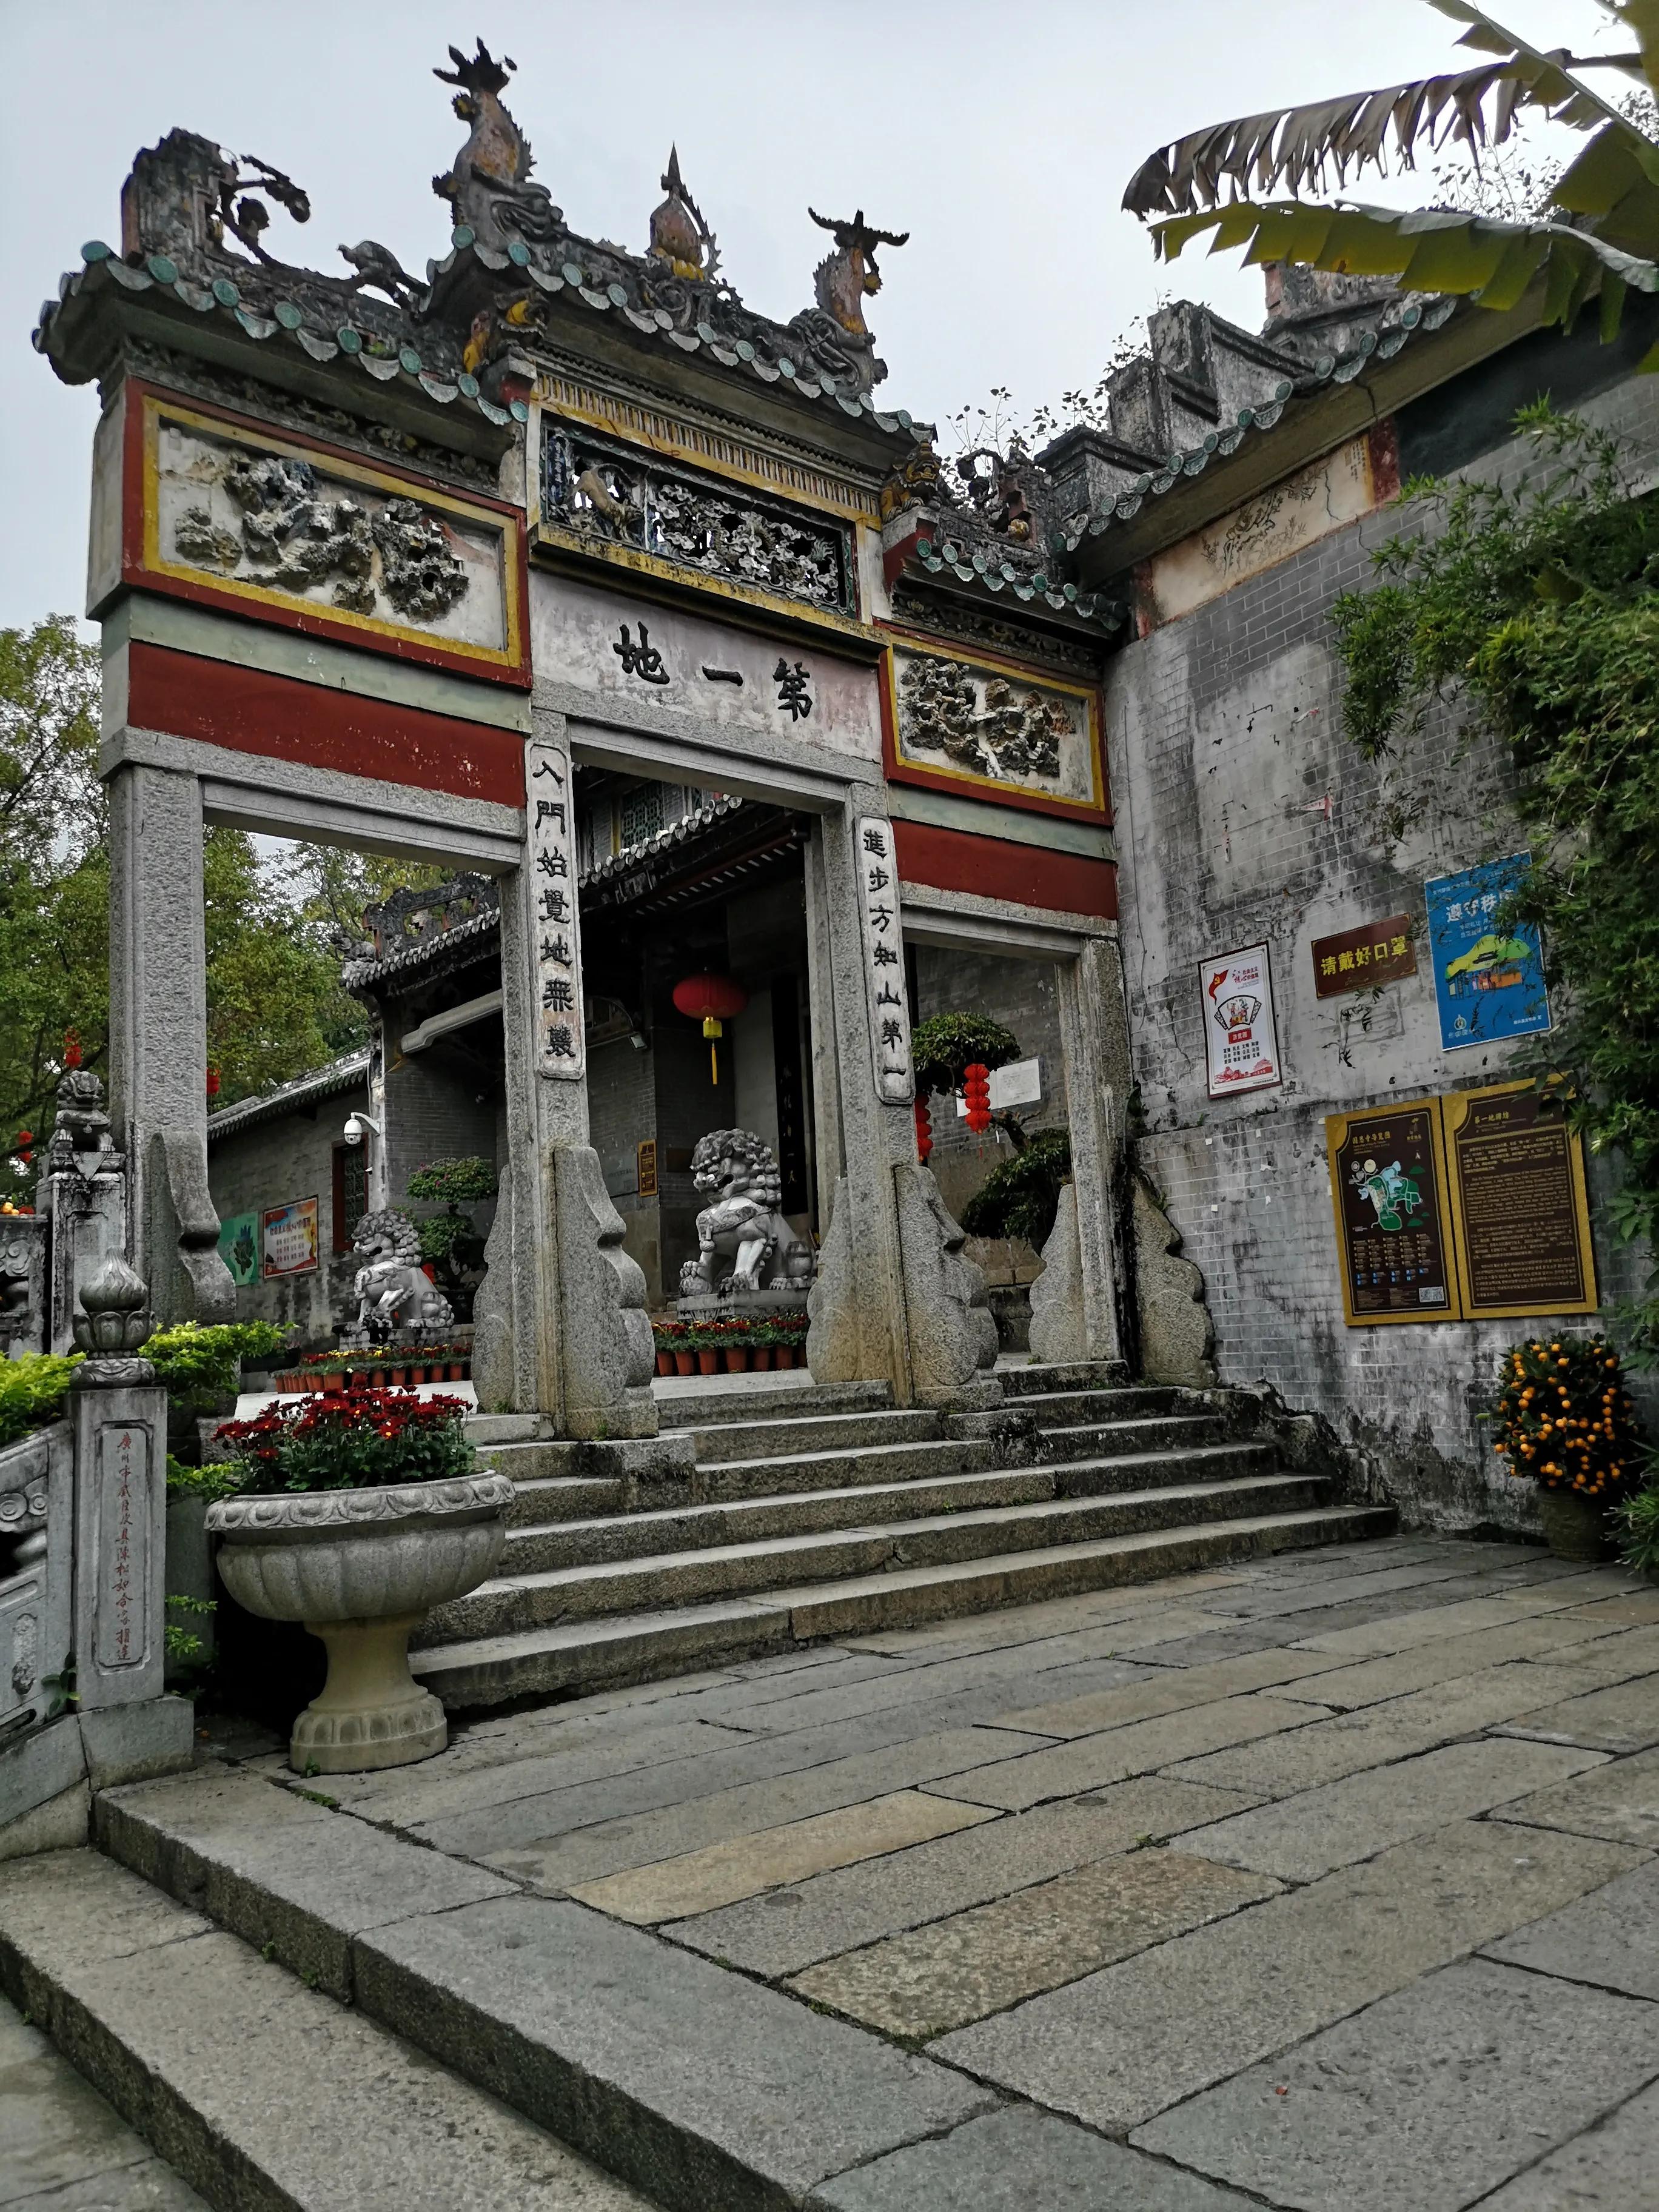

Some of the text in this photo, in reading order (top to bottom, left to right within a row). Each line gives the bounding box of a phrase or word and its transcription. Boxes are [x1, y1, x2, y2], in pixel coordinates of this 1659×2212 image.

[612, 620, 813, 722] 第一地
[1321, 935, 1408, 976] 请戴好口罩
